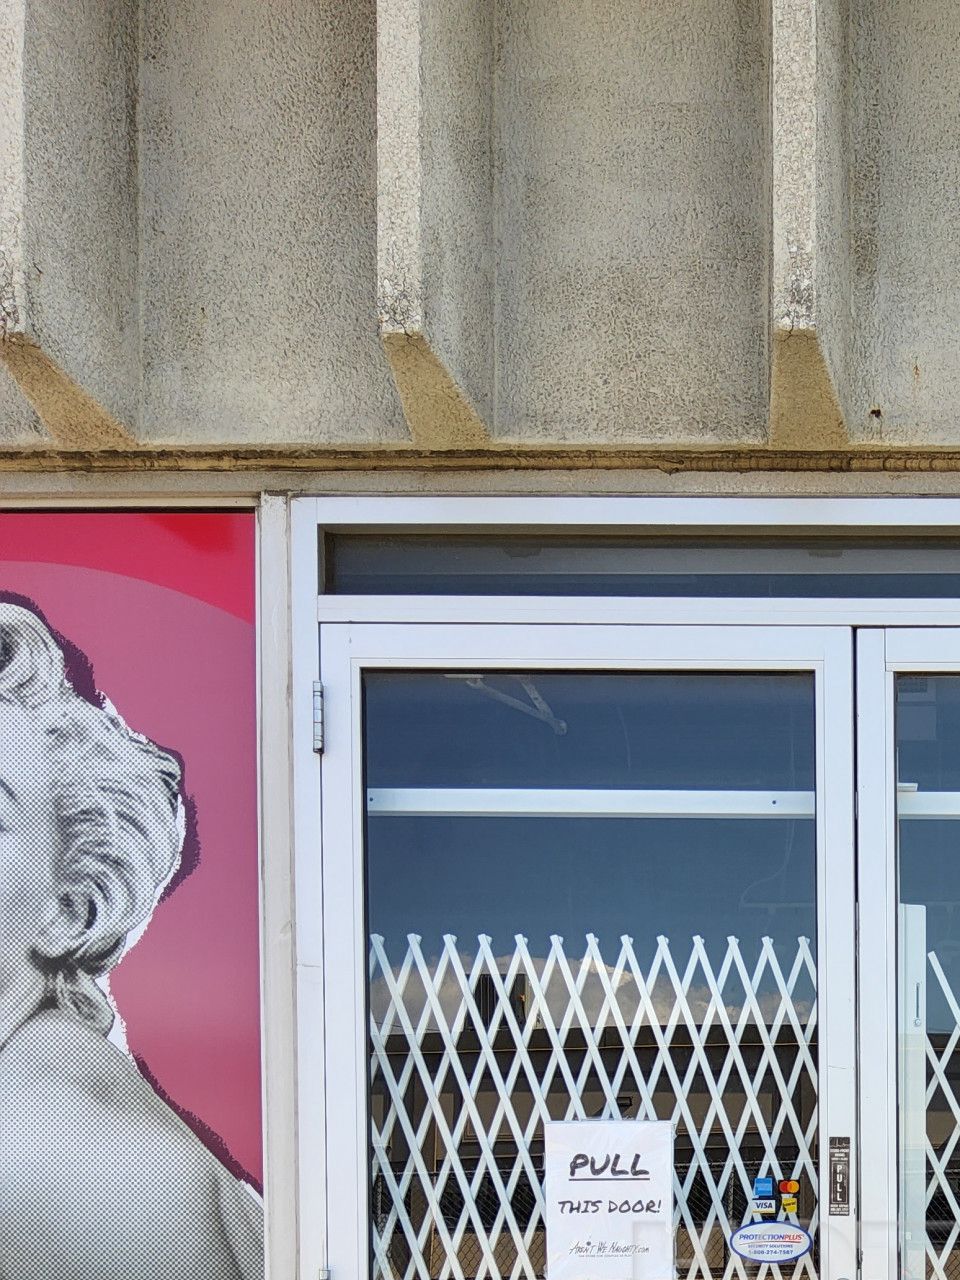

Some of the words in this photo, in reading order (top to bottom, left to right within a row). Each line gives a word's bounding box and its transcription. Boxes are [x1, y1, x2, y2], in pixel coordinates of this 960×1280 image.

[569, 1153, 650, 1178] PULL
[557, 1200, 603, 1215] THIS
[608, 1199, 662, 1214] DOOR!
